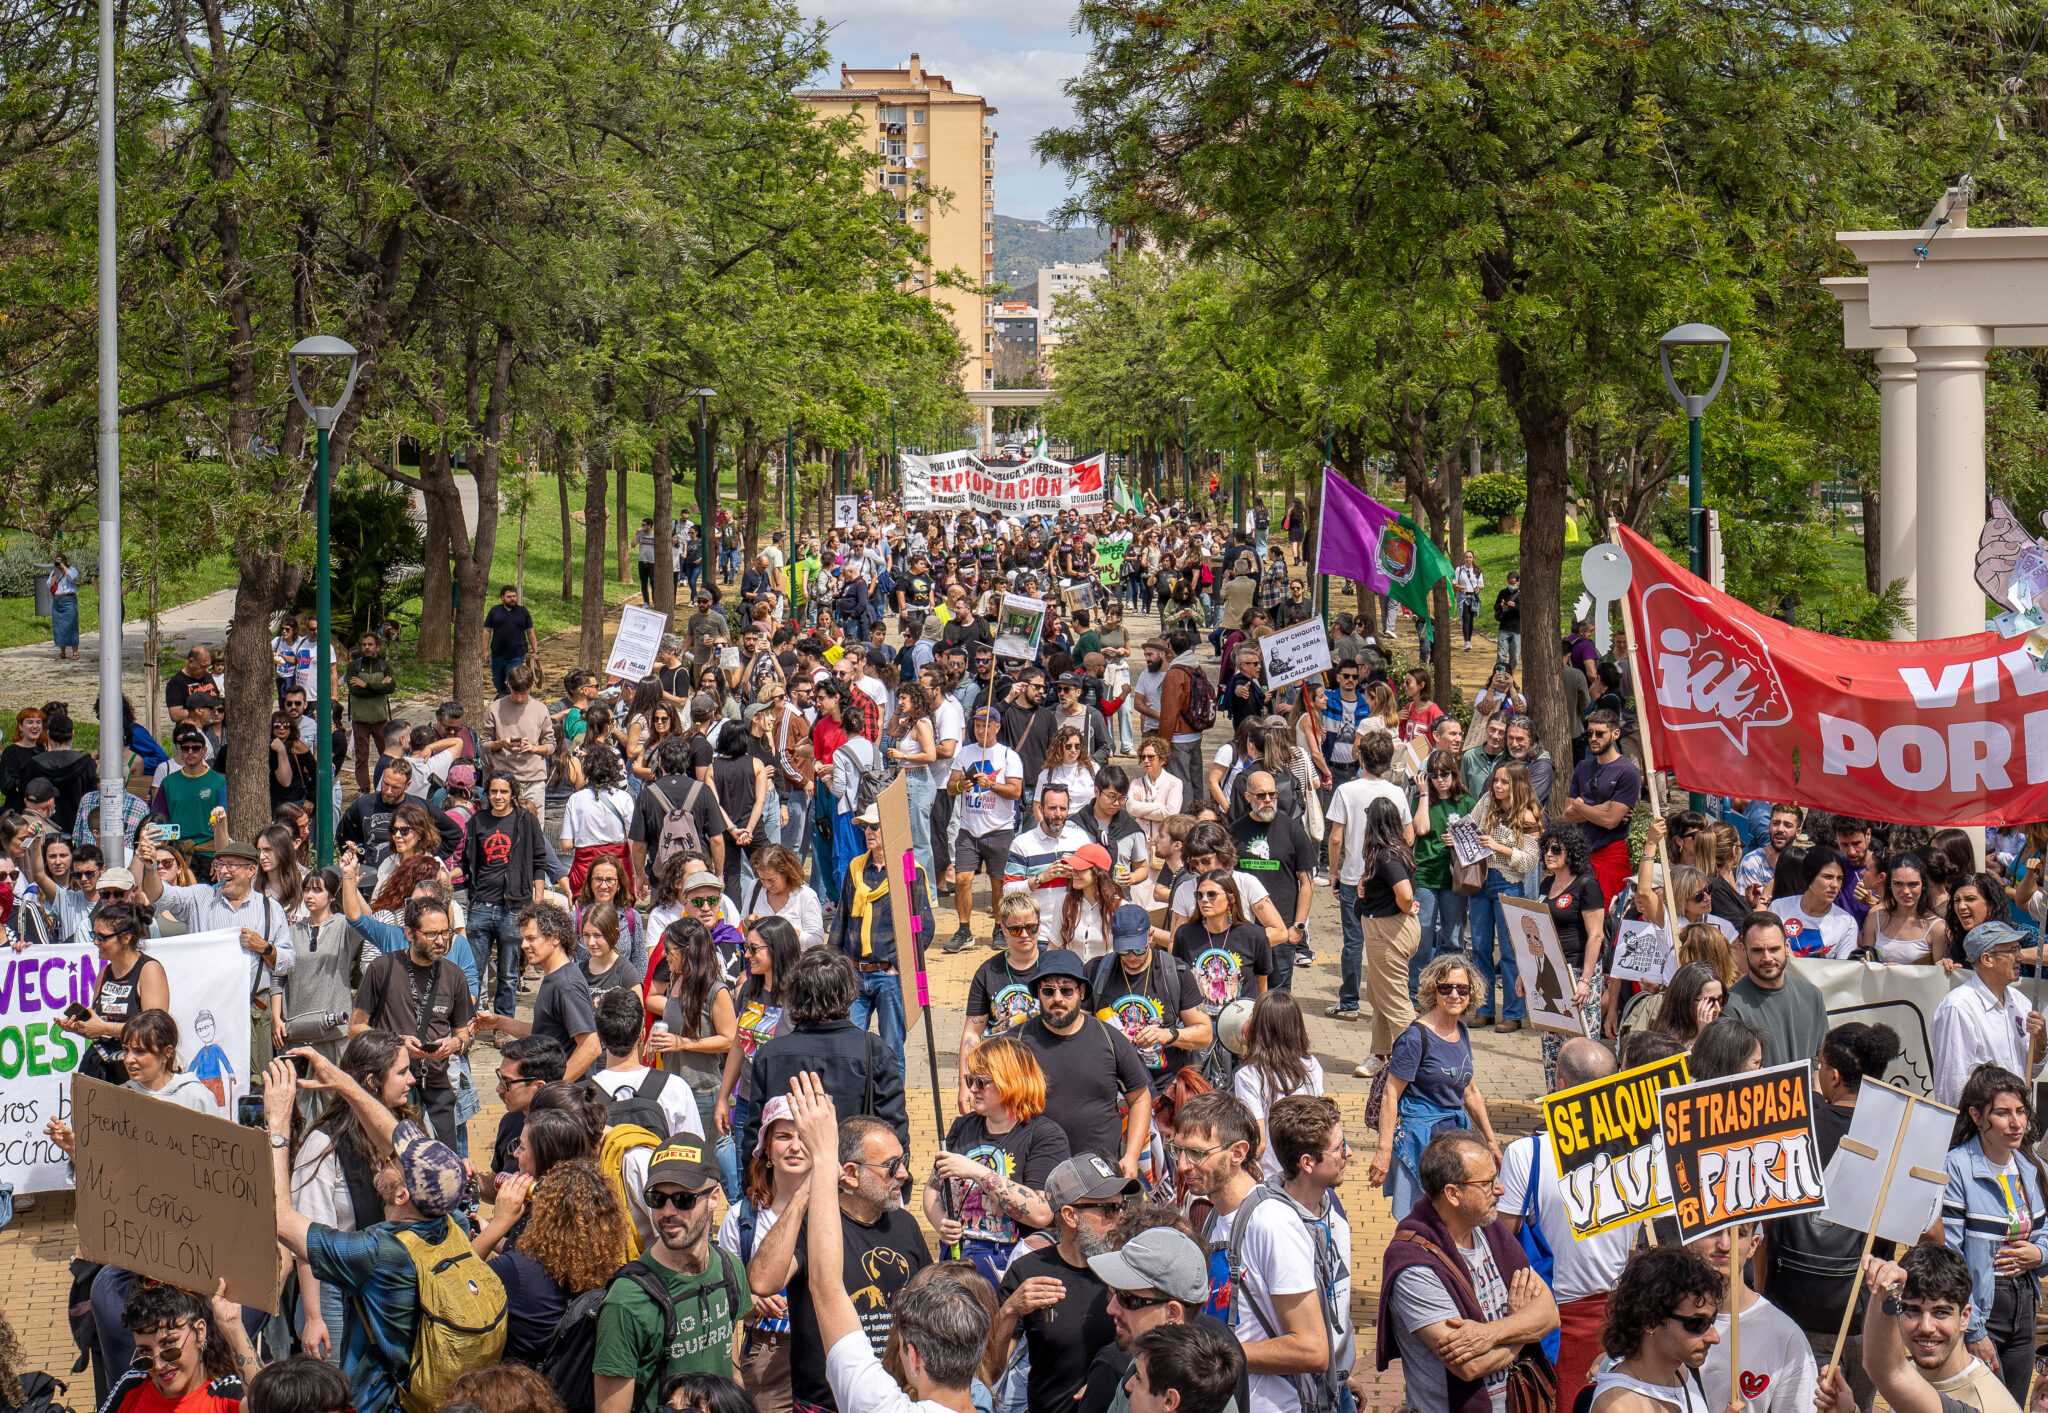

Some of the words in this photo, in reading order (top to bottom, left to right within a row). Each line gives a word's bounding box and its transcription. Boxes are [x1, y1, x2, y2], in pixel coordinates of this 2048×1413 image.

[929, 461, 945, 472] POR
[947, 459, 956, 470] LA
[1023, 462, 1063, 475] UNIVERSAL
[931, 495, 936, 503] A
[986, 498, 1017, 511] BUITRES
[1020, 502, 1026, 511] Y
[1070, 493, 1103, 503] IZQUIERDA
[1275, 636, 1289, 645] HOY
[1290, 624, 1321, 640] CHIQUITO
[1302, 637, 1321, 649] SERÍA
[629, 661, 647, 671] MÁLAGA
[1304, 654, 1313, 662] DE
[1290, 663, 1319, 678] CALZADA
[1818, 712, 2014, 793] POR
[965, 795, 982, 809] MLG
[983, 796, 996, 804] PARA
[1554, 1100, 1590, 1155] SE
[1590, 1070, 1681, 1146] ALQUI
[1665, 1099, 1691, 1146] SE
[1696, 1076, 1808, 1138] TRASPASA
[81, 1088, 139, 1147] frente
[145, 1130, 158, 1146] a
[165, 1135, 188, 1156] su
[192, 1134, 256, 1175] ESPECU
[655, 1148, 696, 1162] PIRELLI
[80, 1157, 120, 1204] Mi
[1700, 1132, 1824, 1218] PARA
[192, 1162, 258, 1208] LACIÓN
[103, 1209, 214, 1280] REXULÓN
[702, 1309, 713, 1325] A
